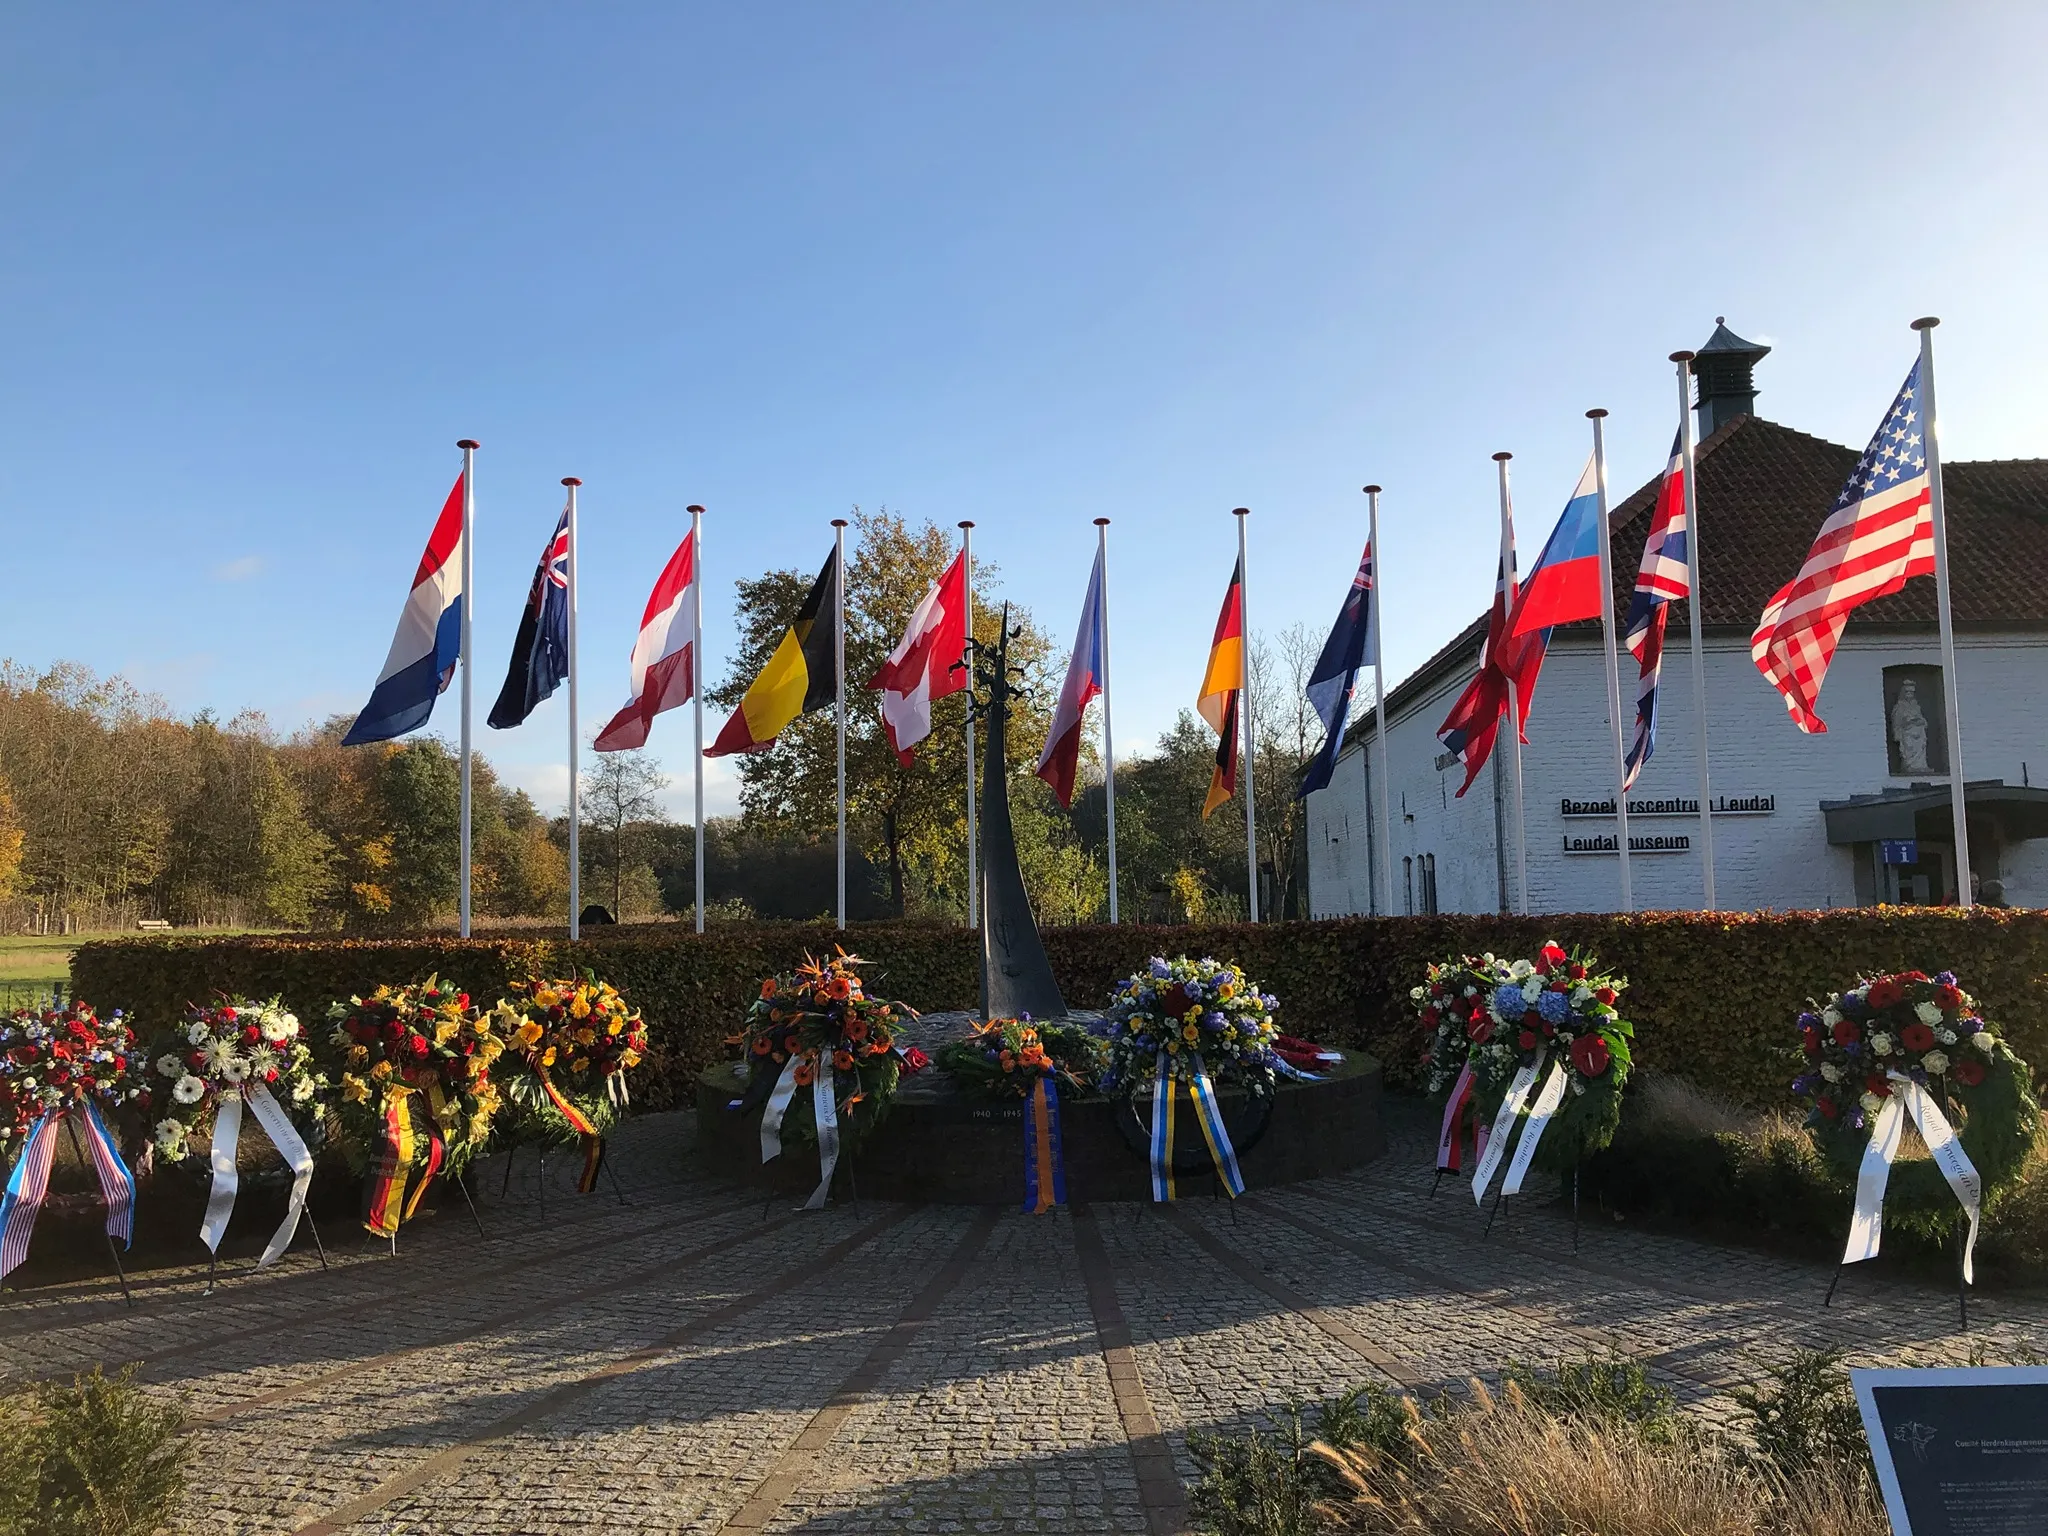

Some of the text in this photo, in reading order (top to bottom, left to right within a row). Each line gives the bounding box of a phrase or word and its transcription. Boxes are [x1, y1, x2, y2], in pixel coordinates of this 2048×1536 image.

[1561, 794, 1775, 815] Bezoekrscentru Leudal
[972, 1110, 991, 1118] 1940
[1003, 1110, 1021, 1118] 1945
[1920, 1103, 1943, 1132] Royal
[1518, 1131, 1536, 1167] Republic
